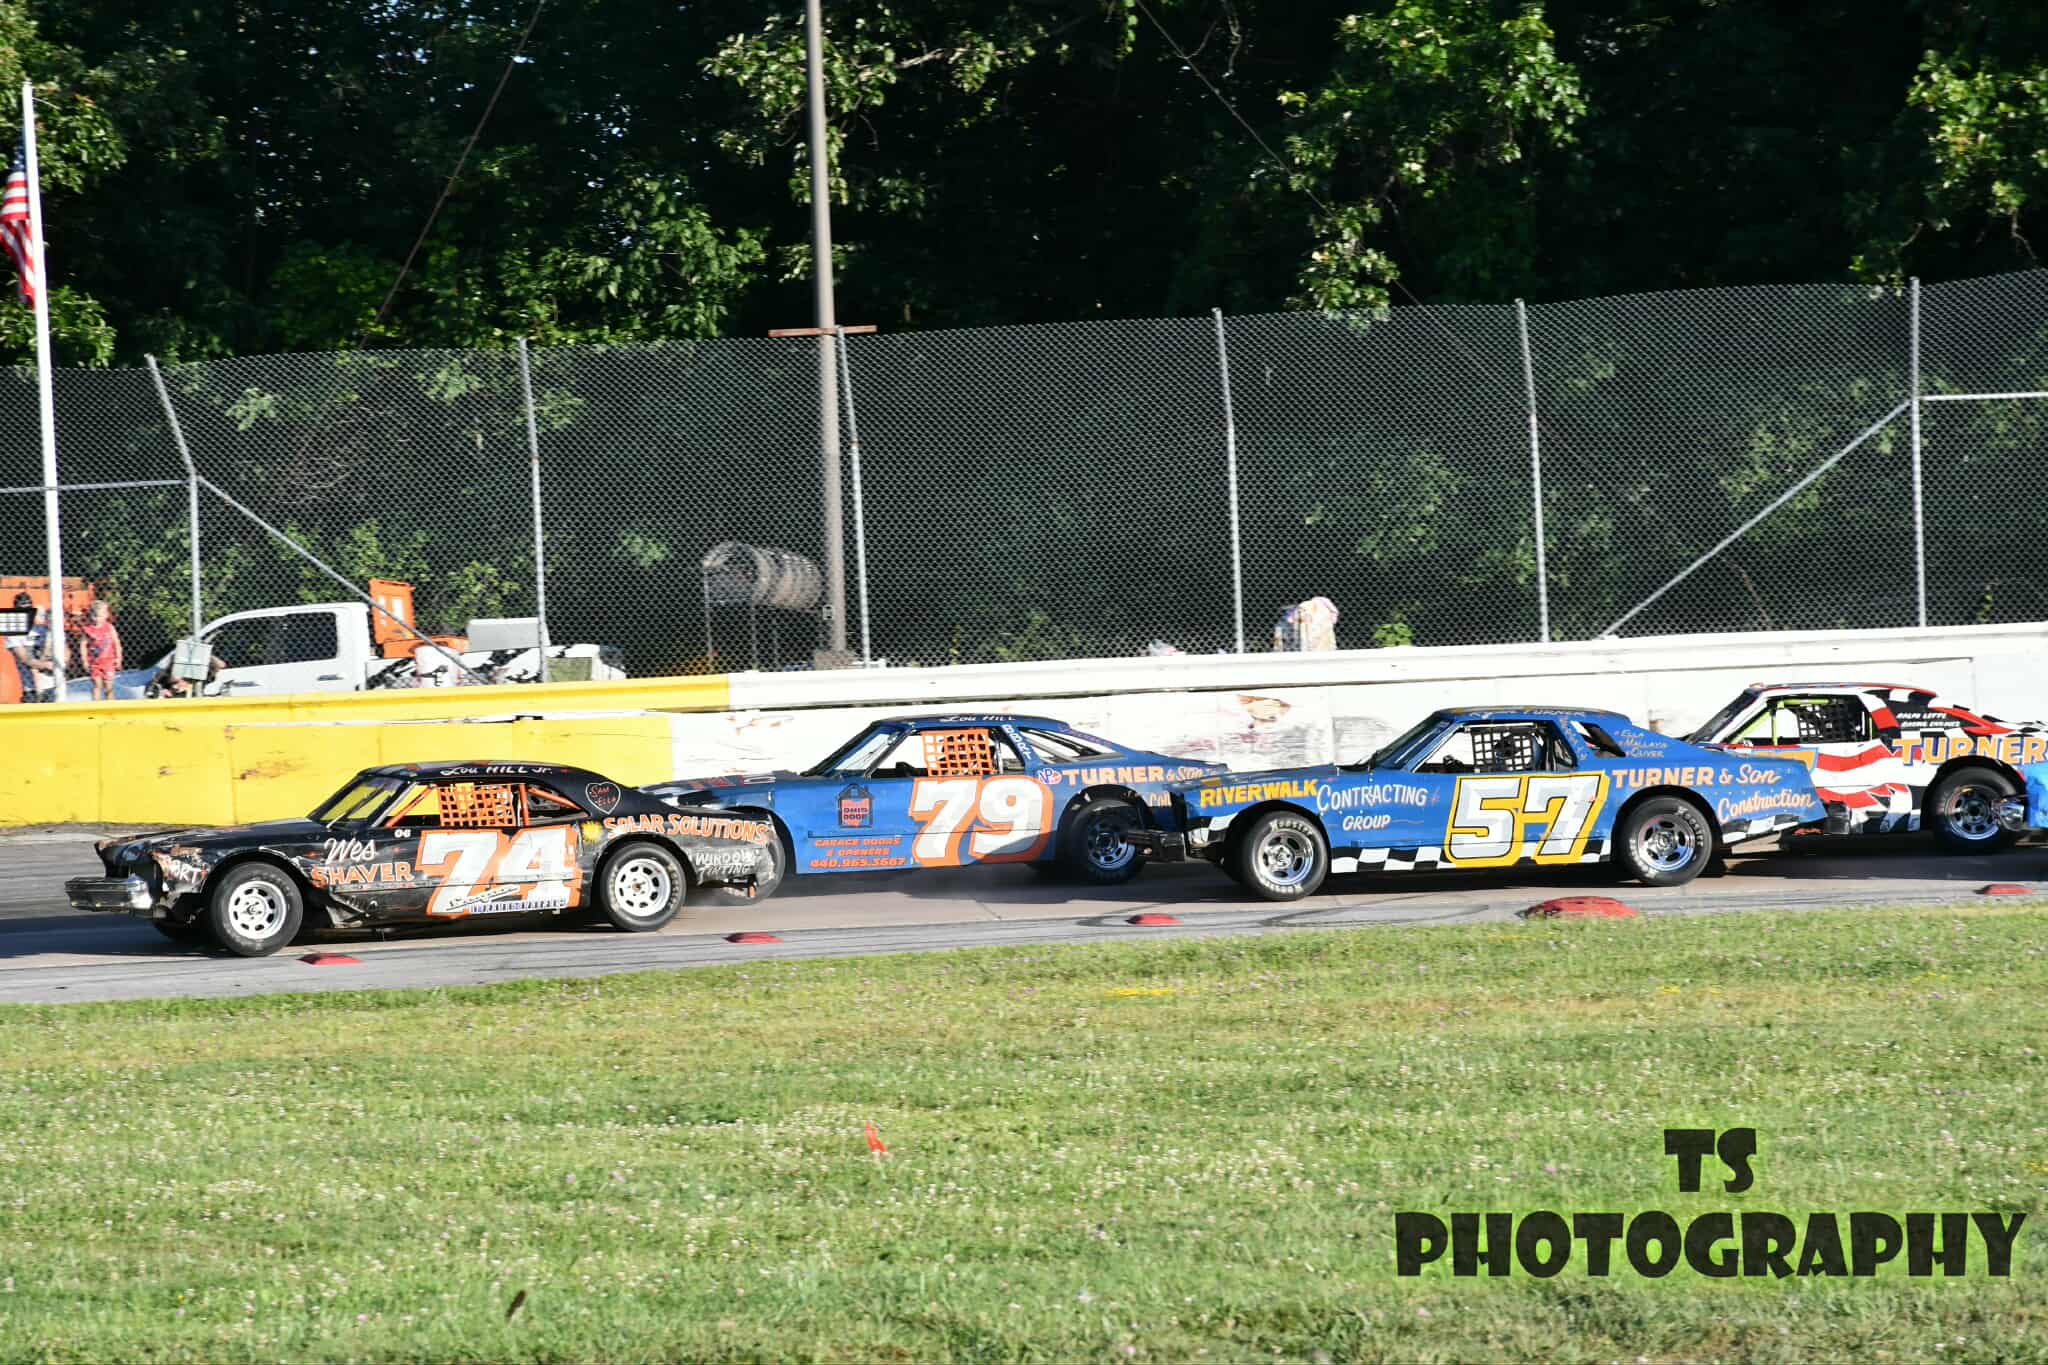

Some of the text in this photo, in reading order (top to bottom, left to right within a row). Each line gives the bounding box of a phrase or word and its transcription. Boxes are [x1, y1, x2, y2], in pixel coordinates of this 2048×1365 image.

[983, 714, 1016, 722] HILL
[1892, 736, 2047, 767] TURNER
[440, 767, 479, 776] Lou
[486, 766, 529, 774] HILL
[1062, 766, 1164, 787] TURNER
[1612, 763, 1782, 789] TURNER & Son
[1200, 778, 1318, 808] RIVERWALK
[1717, 787, 1816, 824] Construction
[603, 813, 769, 846] SOLAR SOLUTIONS
[908, 774, 1054, 868] 79
[1342, 814, 1391, 832] GROUP
[1444, 770, 1611, 869] 57
[324, 837, 379, 865] Wes
[311, 861, 415, 889] SHAVER
[414, 824, 583, 919] 74
